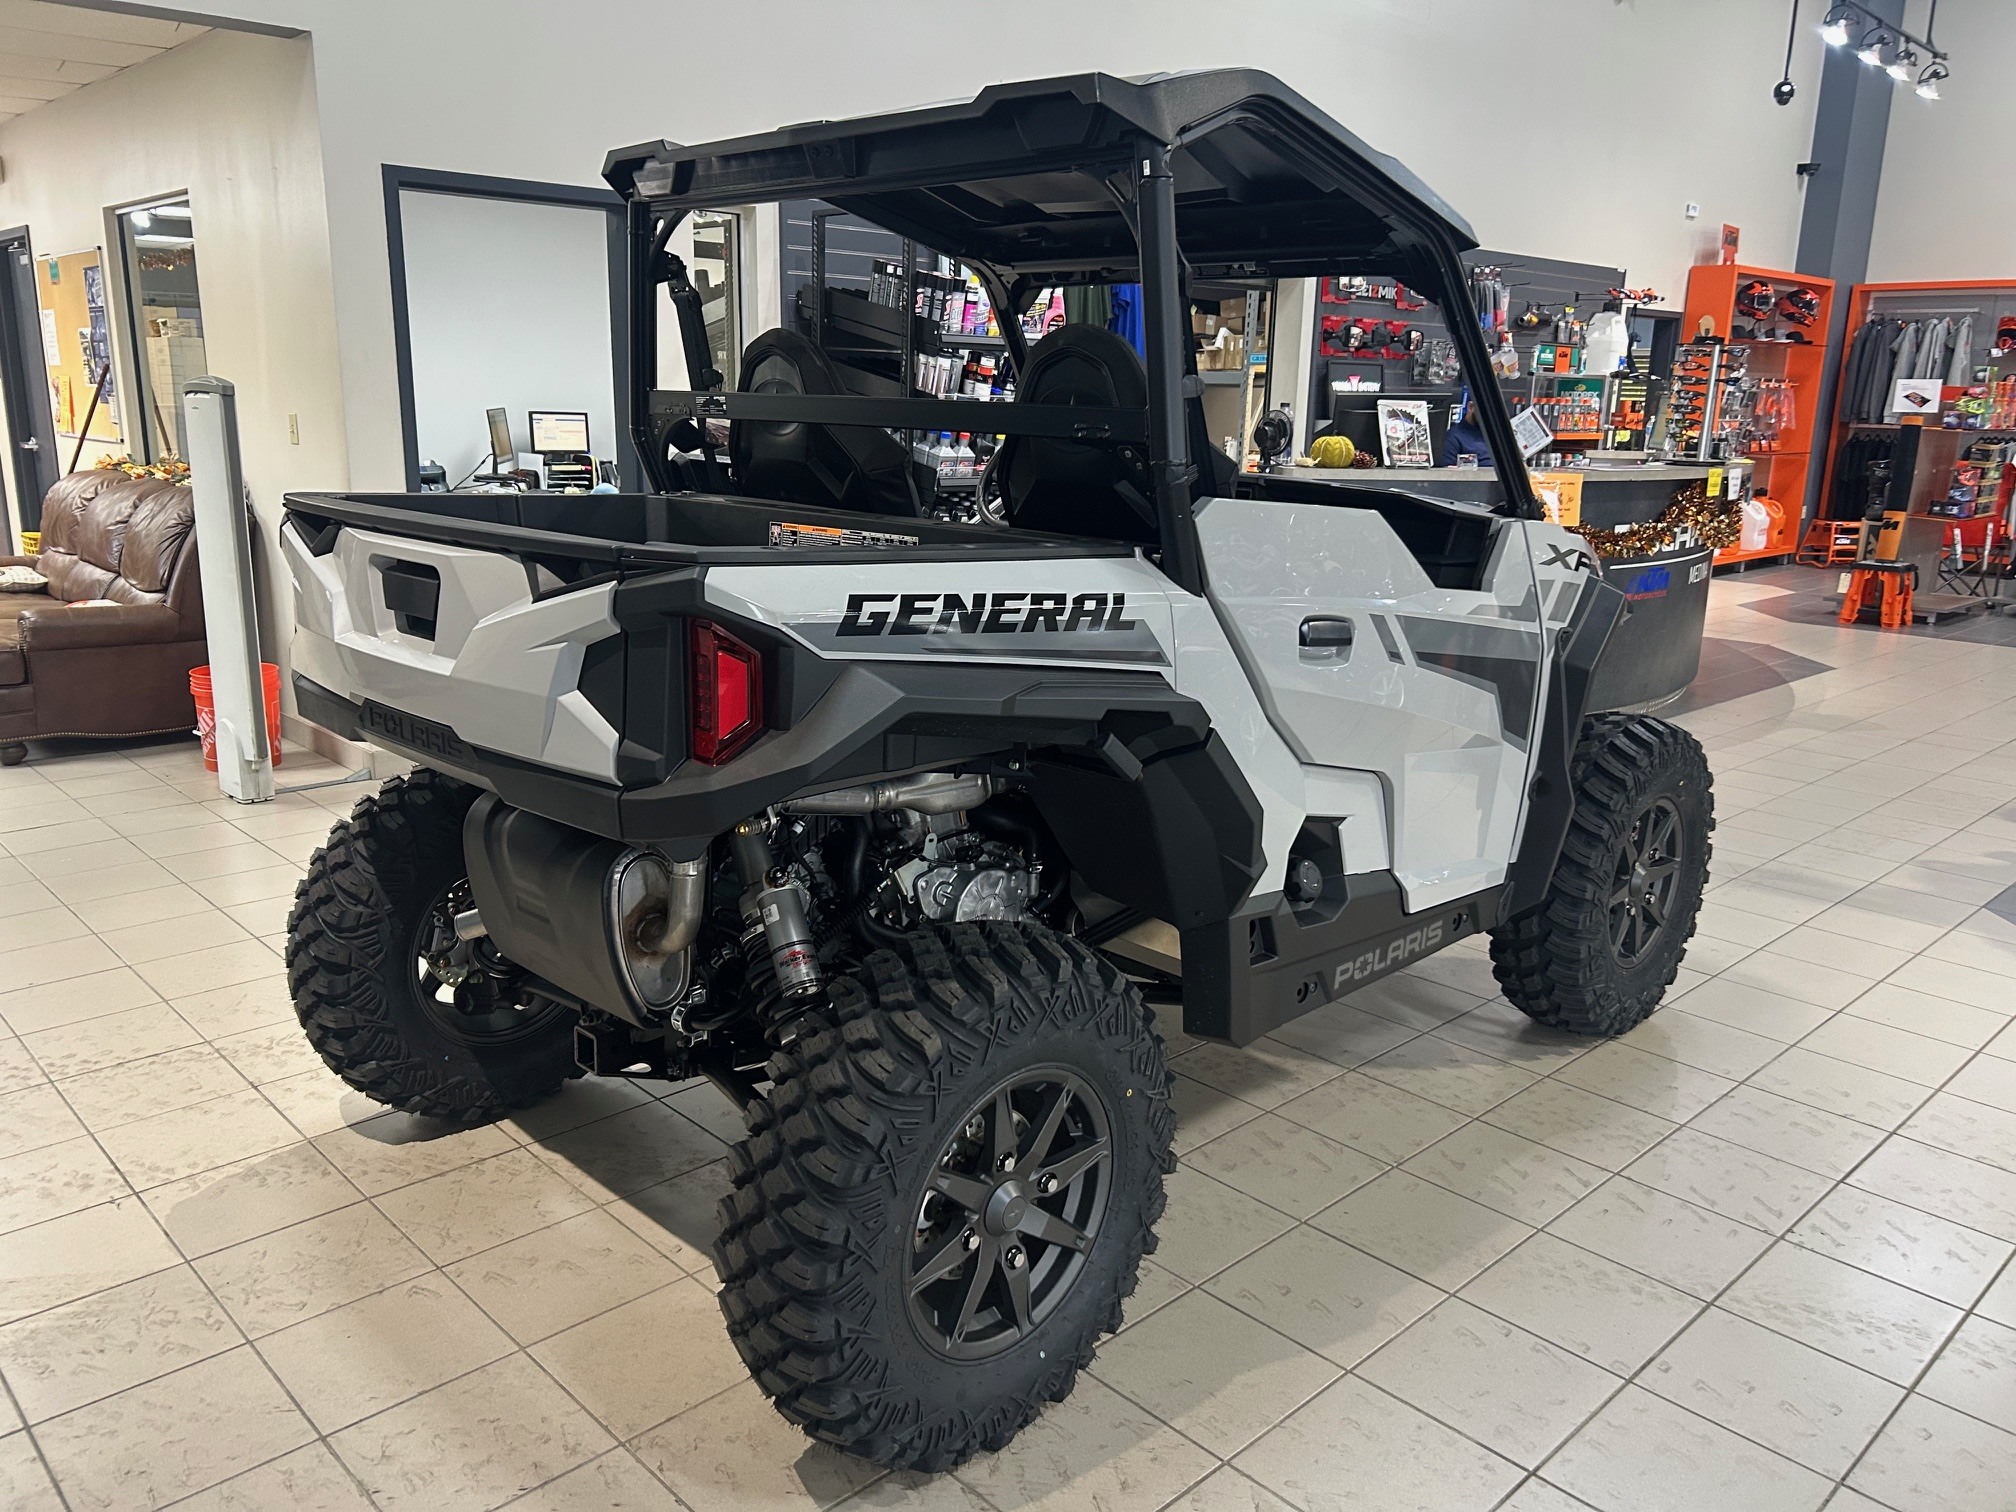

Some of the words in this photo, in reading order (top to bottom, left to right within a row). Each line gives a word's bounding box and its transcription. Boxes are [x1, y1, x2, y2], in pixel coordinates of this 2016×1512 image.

[1356, 284, 1397, 300] EIZMIK
[835, 592, 1137, 637] GENERAL
[368, 705, 464, 756] POLARIS
[1333, 920, 1443, 990] POLARIS
